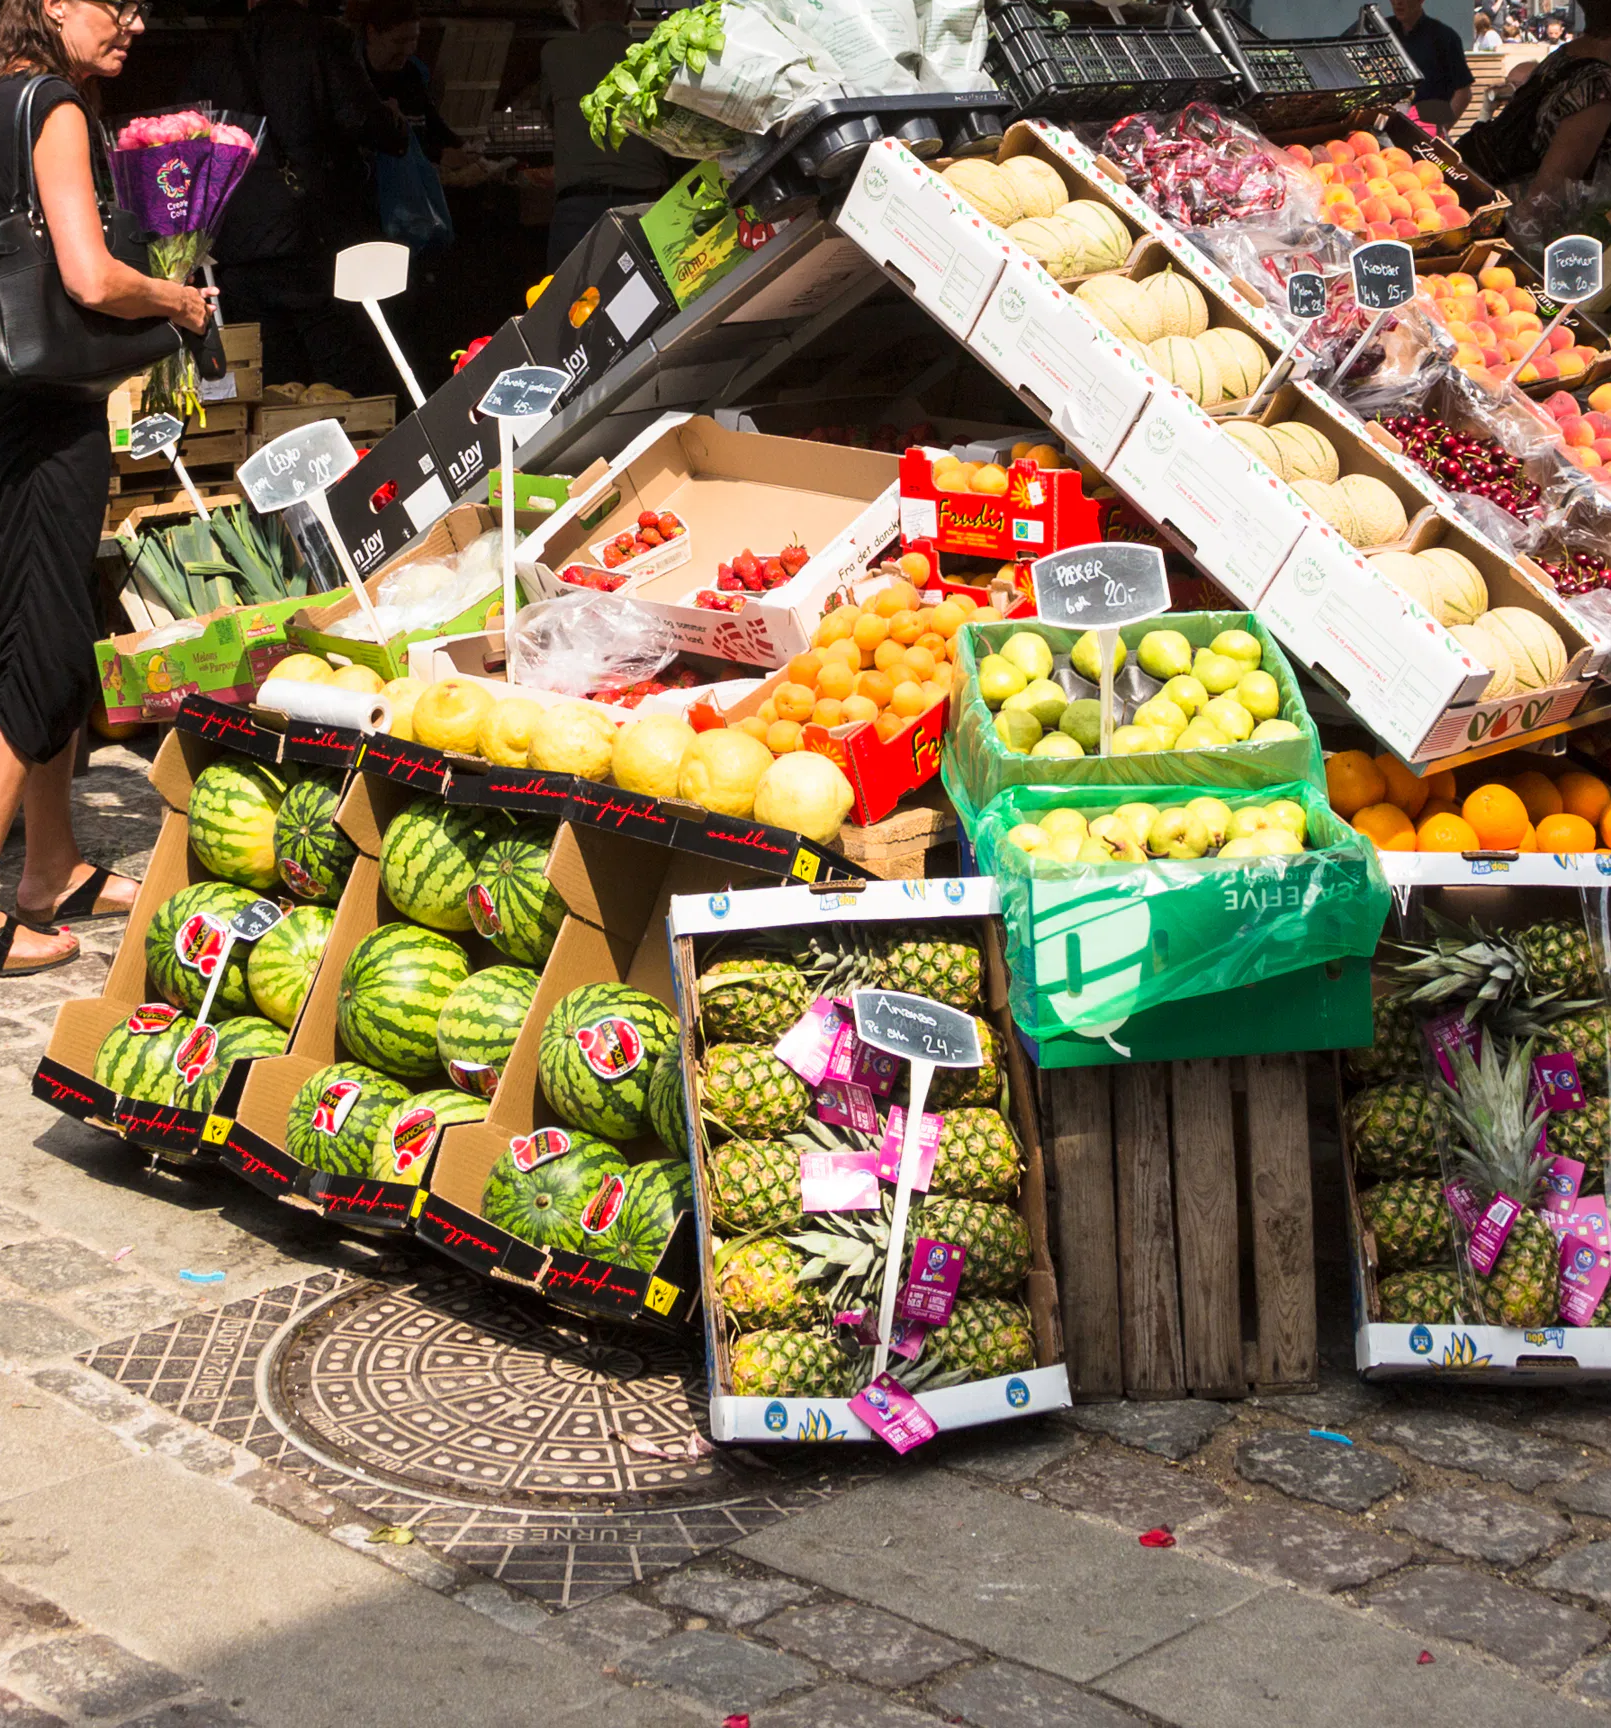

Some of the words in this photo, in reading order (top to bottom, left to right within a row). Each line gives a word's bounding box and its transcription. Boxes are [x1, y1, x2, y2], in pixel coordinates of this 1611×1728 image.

[562, 343, 588, 379] joy
[461, 439, 484, 478] joy
[362, 528, 385, 568] joy
[838, 563, 856, 581] Fra
[857, 544, 873, 564] det
[192, 651, 218, 665] Melons
[209, 660, 239, 674] Purpose
[490, 777, 568, 799] seedless
[707, 829, 789, 856] seedless
[1224, 882, 1354, 911] CAEFIVE
[875, 995, 937, 1027] Ananas
[309, 1411, 357, 1448] FURNES
[505, 1527, 643, 1543] FURNES
